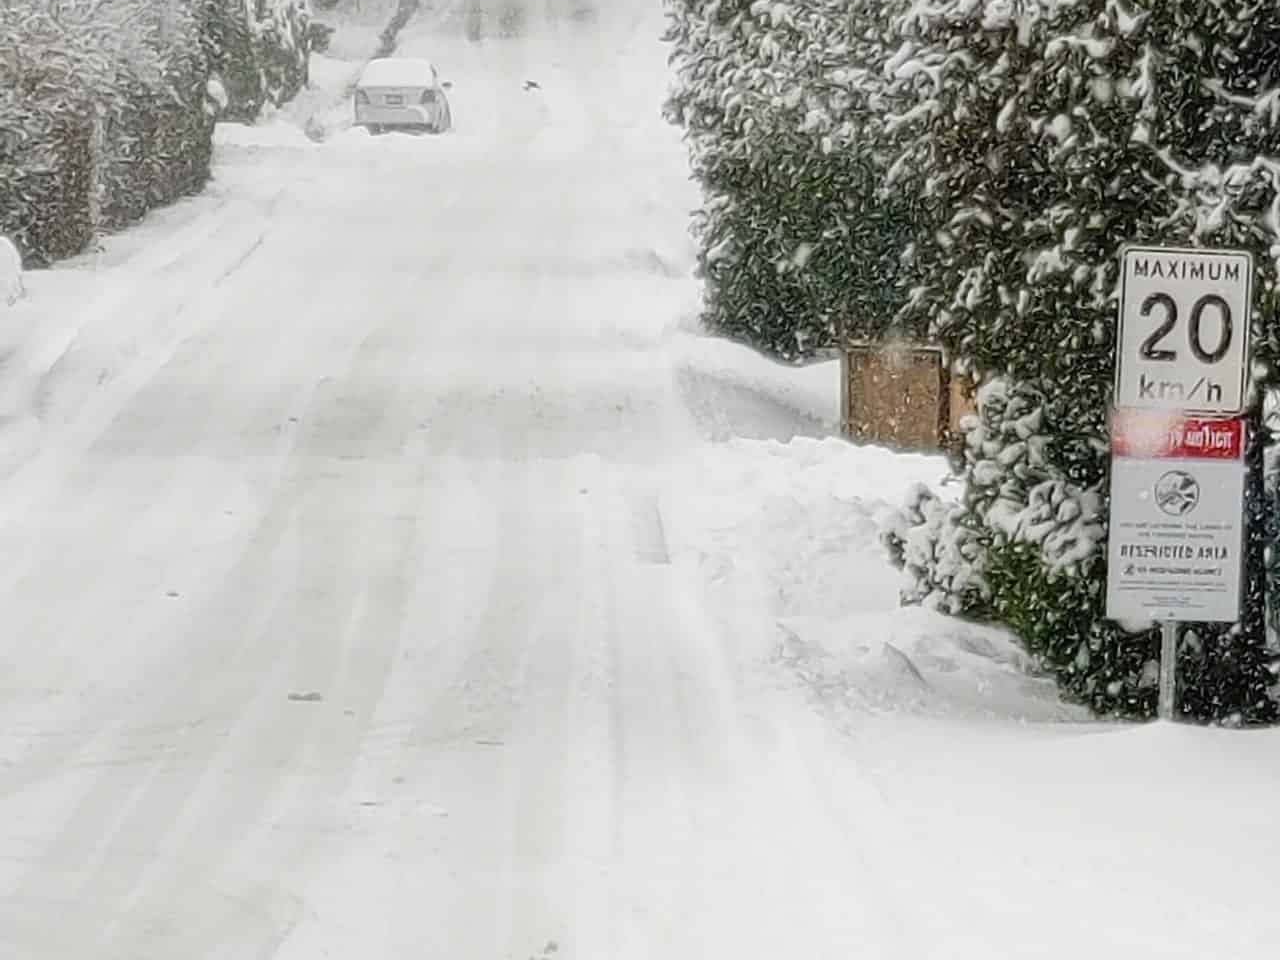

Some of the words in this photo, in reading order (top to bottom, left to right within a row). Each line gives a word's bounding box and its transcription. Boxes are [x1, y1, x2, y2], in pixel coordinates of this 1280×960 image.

[1134, 259, 1239, 282] MAXIMUM
[1139, 292, 1233, 364] 20
[1138, 373, 1222, 402] km/h
